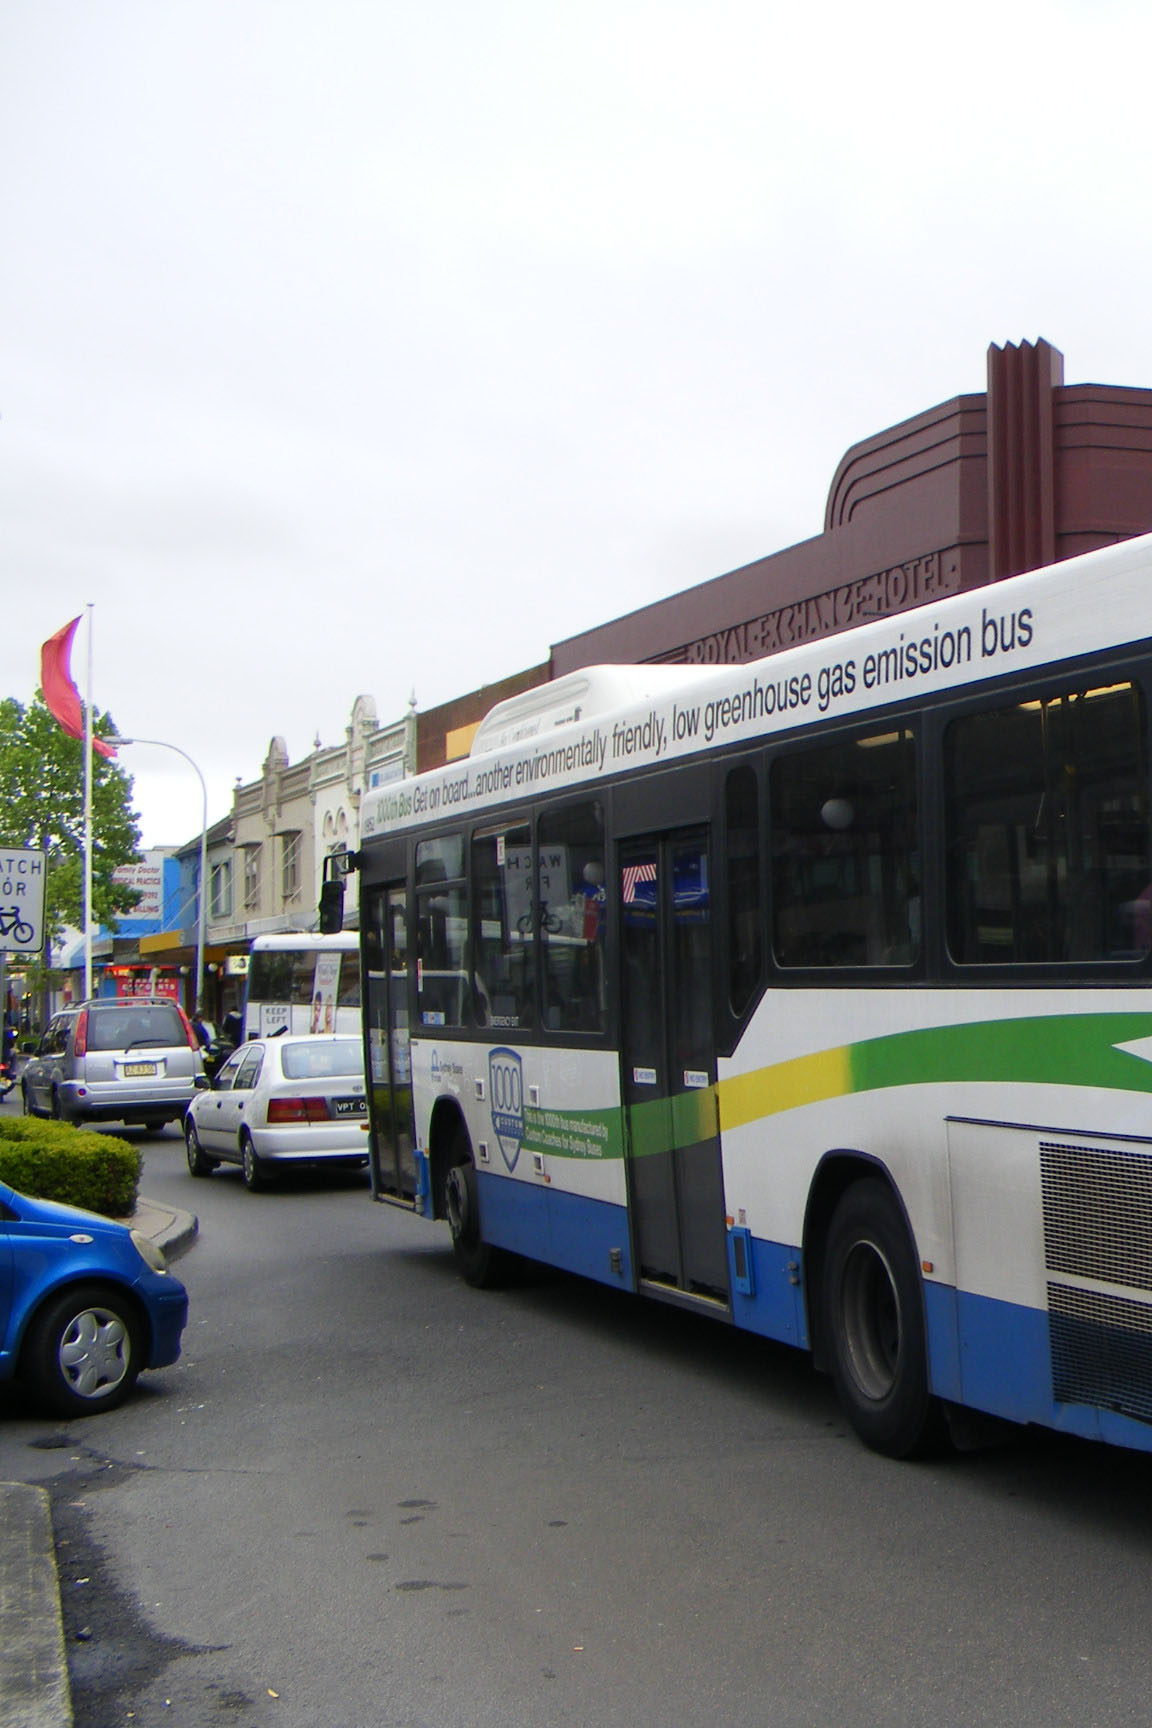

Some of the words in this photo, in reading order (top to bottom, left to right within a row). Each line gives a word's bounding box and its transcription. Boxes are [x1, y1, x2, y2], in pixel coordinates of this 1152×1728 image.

[875, 552, 949, 610] HOTEL
[413, 786, 427, 814] Get
[429, 786, 440, 809] on
[516, 728, 606, 788] environmentally
[612, 711, 667, 758] friendly,
[672, 704, 701, 742] low
[704, 672, 812, 742] greenhouse
[818, 660, 856, 712] gas
[863, 623, 972, 690] emission
[982, 608, 1033, 658] bus
[265, 1007, 287, 1015] KEEP
[266, 1016, 287, 1024] LEFT
[491, 1064, 520, 1113] 1000
[337, 1102, 354, 1111] VPT
